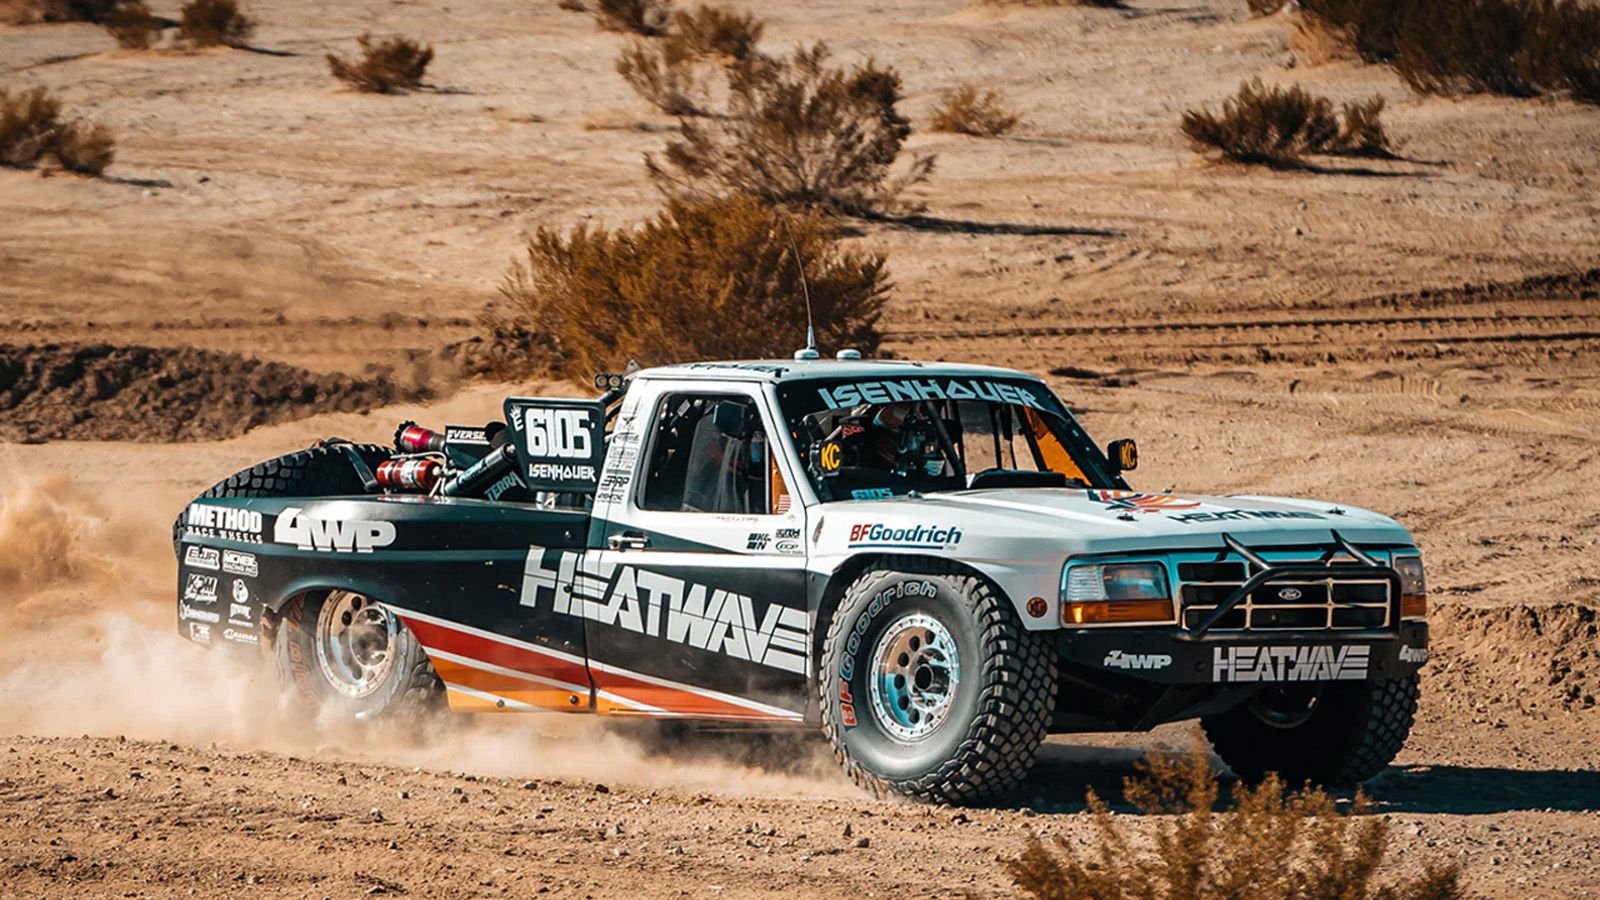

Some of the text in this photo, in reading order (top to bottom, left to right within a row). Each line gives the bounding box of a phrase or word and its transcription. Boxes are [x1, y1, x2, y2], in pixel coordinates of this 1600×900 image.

[817, 379, 1045, 409] ISENHAUER
[525, 409, 592, 459] 6105
[821, 443, 840, 470] KC
[1121, 441, 1135, 468] KC
[529, 463, 596, 483] ISENHAUER
[188, 503, 262, 533] METHOD
[274, 507, 396, 553] 4WP
[187, 526, 263, 544] RACE WHEELS
[849, 524, 962, 544] BFGoodrich
[520, 545, 810, 677] HEATWAVE
[1212, 645, 1370, 682] HEATWAVE
